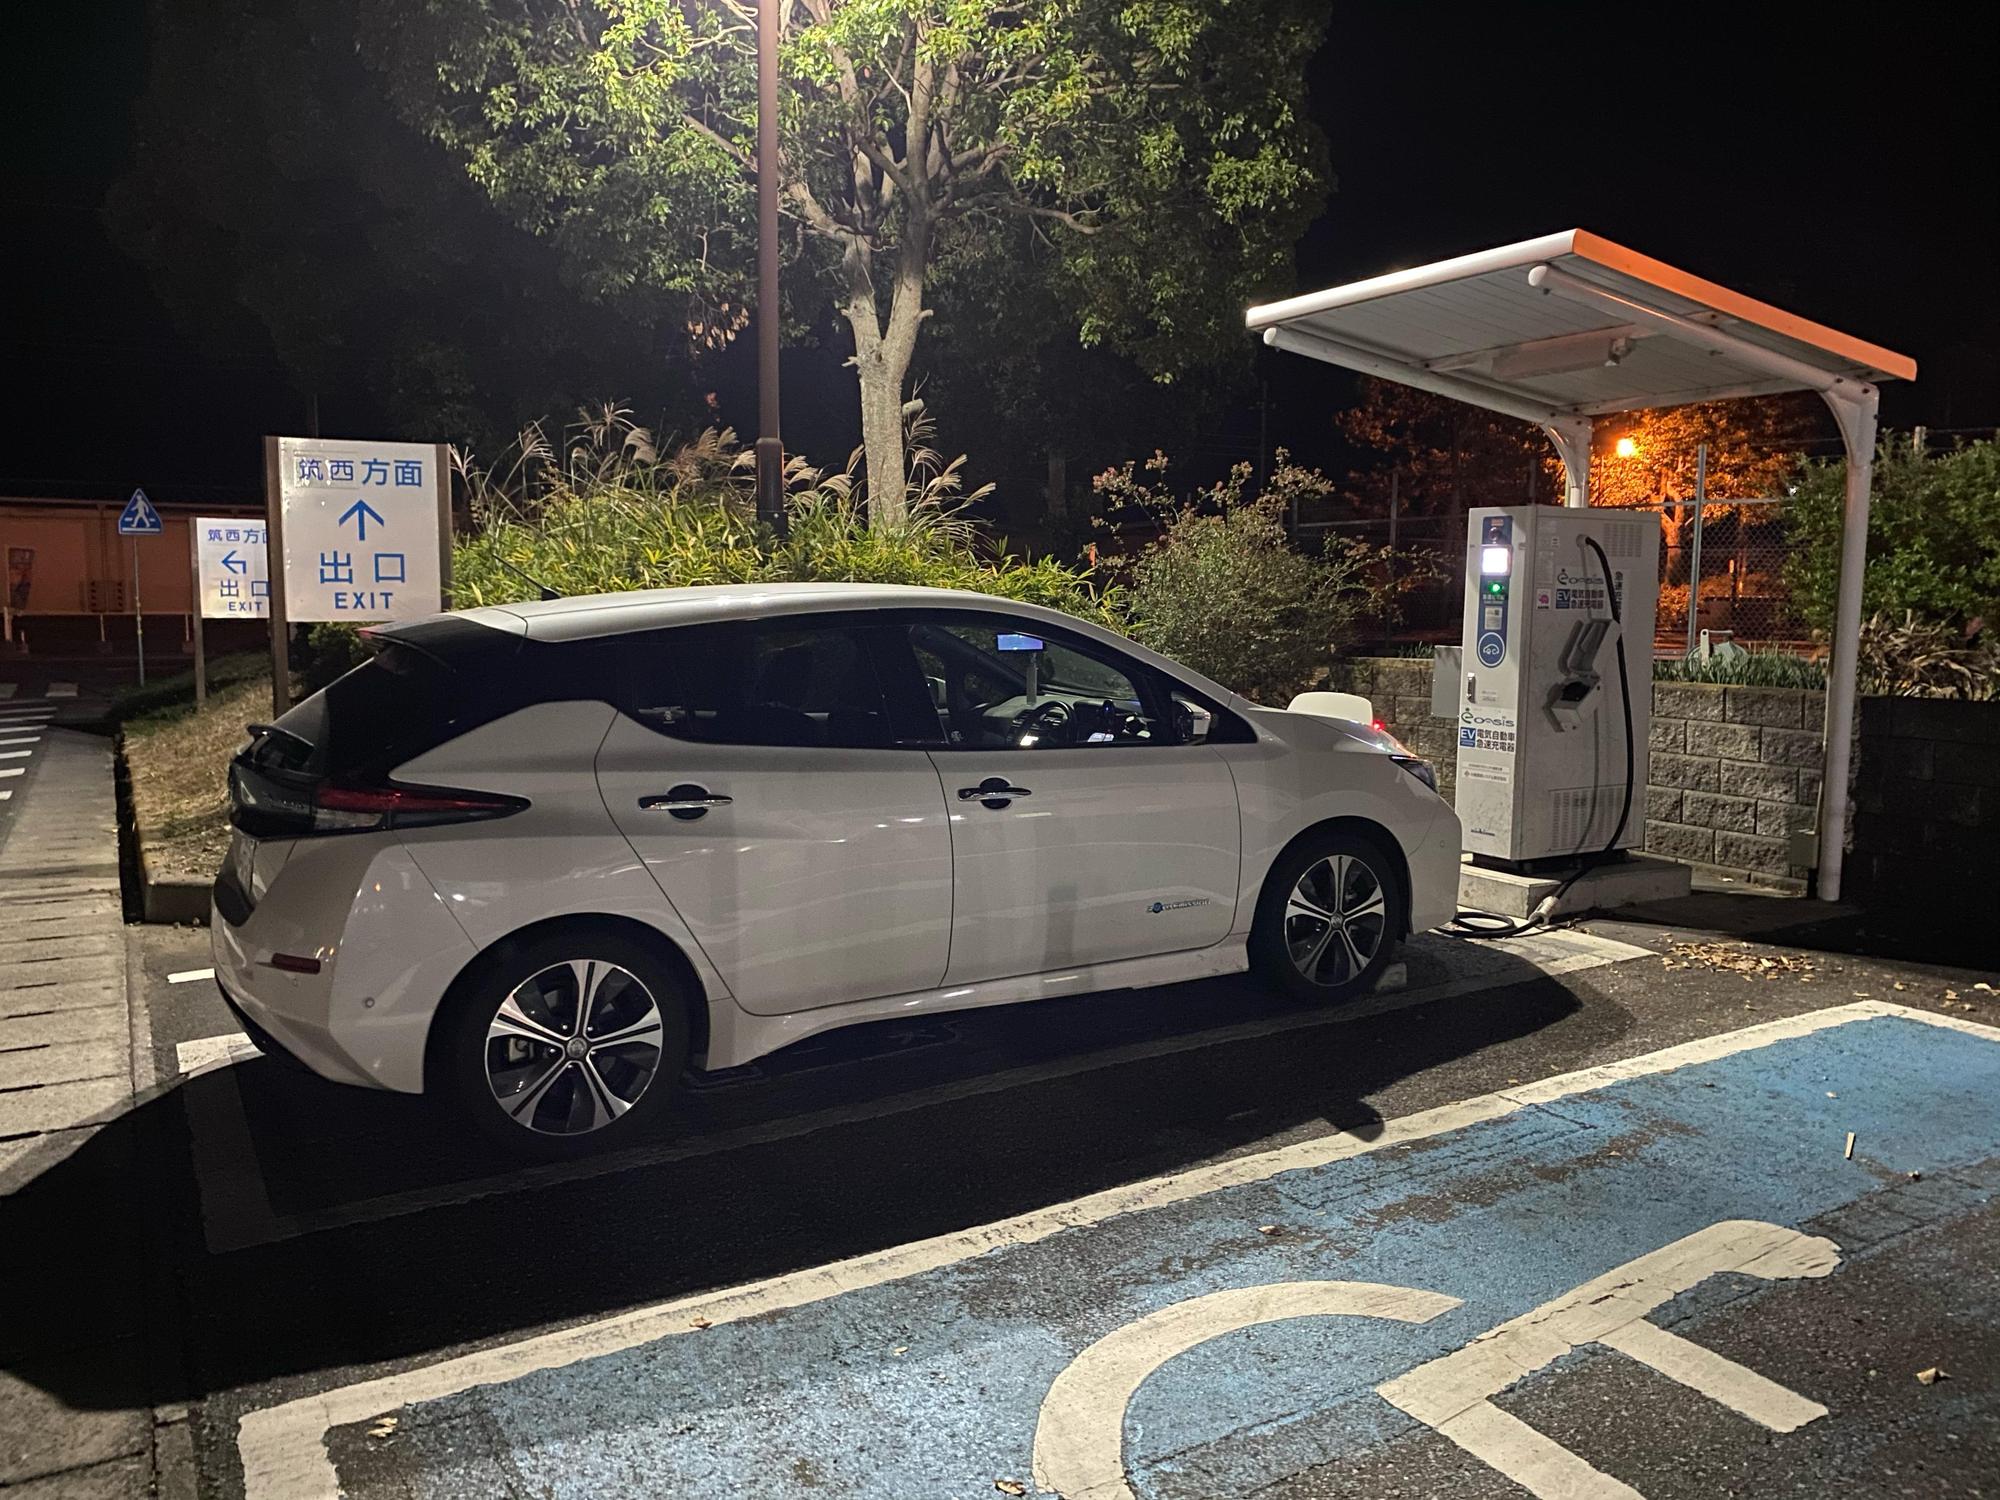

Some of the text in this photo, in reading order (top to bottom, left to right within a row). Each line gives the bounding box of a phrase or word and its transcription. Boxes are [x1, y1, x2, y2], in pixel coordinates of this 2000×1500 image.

[299, 458, 423, 487] 筑西方面
[208, 528, 267, 544] 筑西方
[319, 551, 405, 584] 出口
[220, 579, 270, 597] 出口
[1557, 590, 1570, 601] EV
[228, 602, 262, 611] EXIT
[334, 592, 393, 609] EXIT
[1461, 728, 1476, 739] EV
